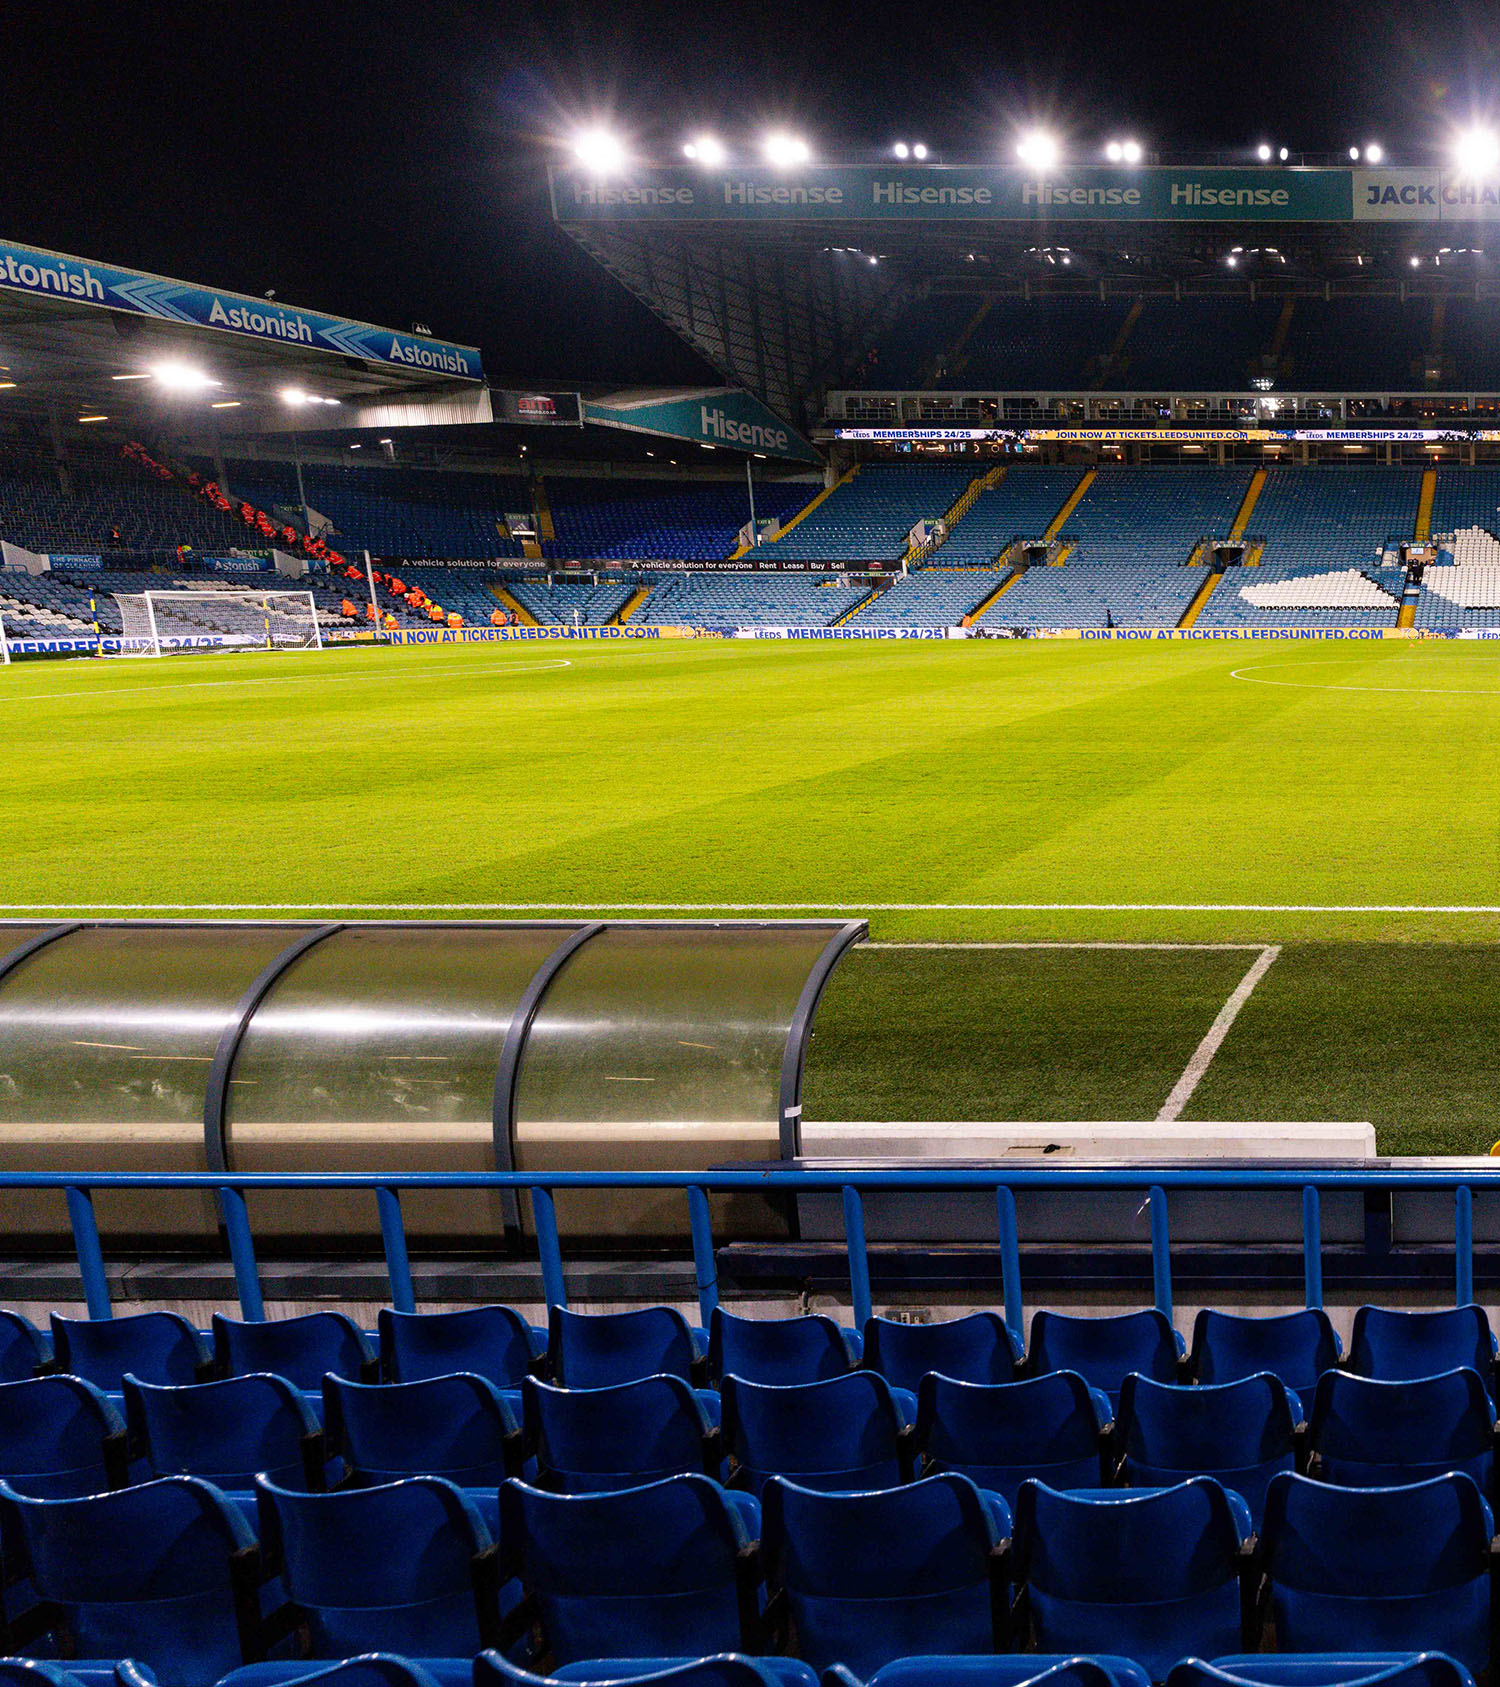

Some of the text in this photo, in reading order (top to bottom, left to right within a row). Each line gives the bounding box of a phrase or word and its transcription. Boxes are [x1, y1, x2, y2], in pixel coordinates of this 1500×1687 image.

[724, 182, 842, 204] Hisense
[873, 182, 991, 204] Hisense
[1022, 183, 1140, 205] Hisense
[1171, 183, 1289, 205] Hisense
[1367, 185, 1436, 206] JACK
[209, 298, 313, 343] Astonish
[390, 337, 468, 375] Astonish
[700, 405, 789, 450] Hisense
[873, 430, 942, 439] MEMBERSHIPS
[944, 430, 972, 439] 24/25
[1056, 431, 1248, 440] JOIN NOW AT TICKETS.LEEDSUNITED.COM
[1326, 431, 1395, 440] MEMBERSHIPS
[1397, 431, 1424, 440] 24/25
[214, 560, 260, 571] Astonish
[402, 559, 546, 570] A vehicle solution for everyone
[640, 561, 671, 570] vehicle
[672, 561, 703, 570] solution
[705, 561, 717, 570] for
[718, 562, 753, 572] everyone
[759, 562, 778, 570] Rent
[783, 562, 805, 570] Lease
[810, 562, 825, 572] Buy
[830, 562, 845, 570] Sell
[407, 630, 439, 644] NOW
[442, 629, 457, 643] AT
[461, 627, 660, 642] TICKETS.LEEDSUNITED.COM
[754, 629, 943, 640] LEEDS MEMBERSHIPS 24/25
[1079, 629, 1384, 640] JOIN NOW AT TICKETS.LEEDSUNITED.COM
